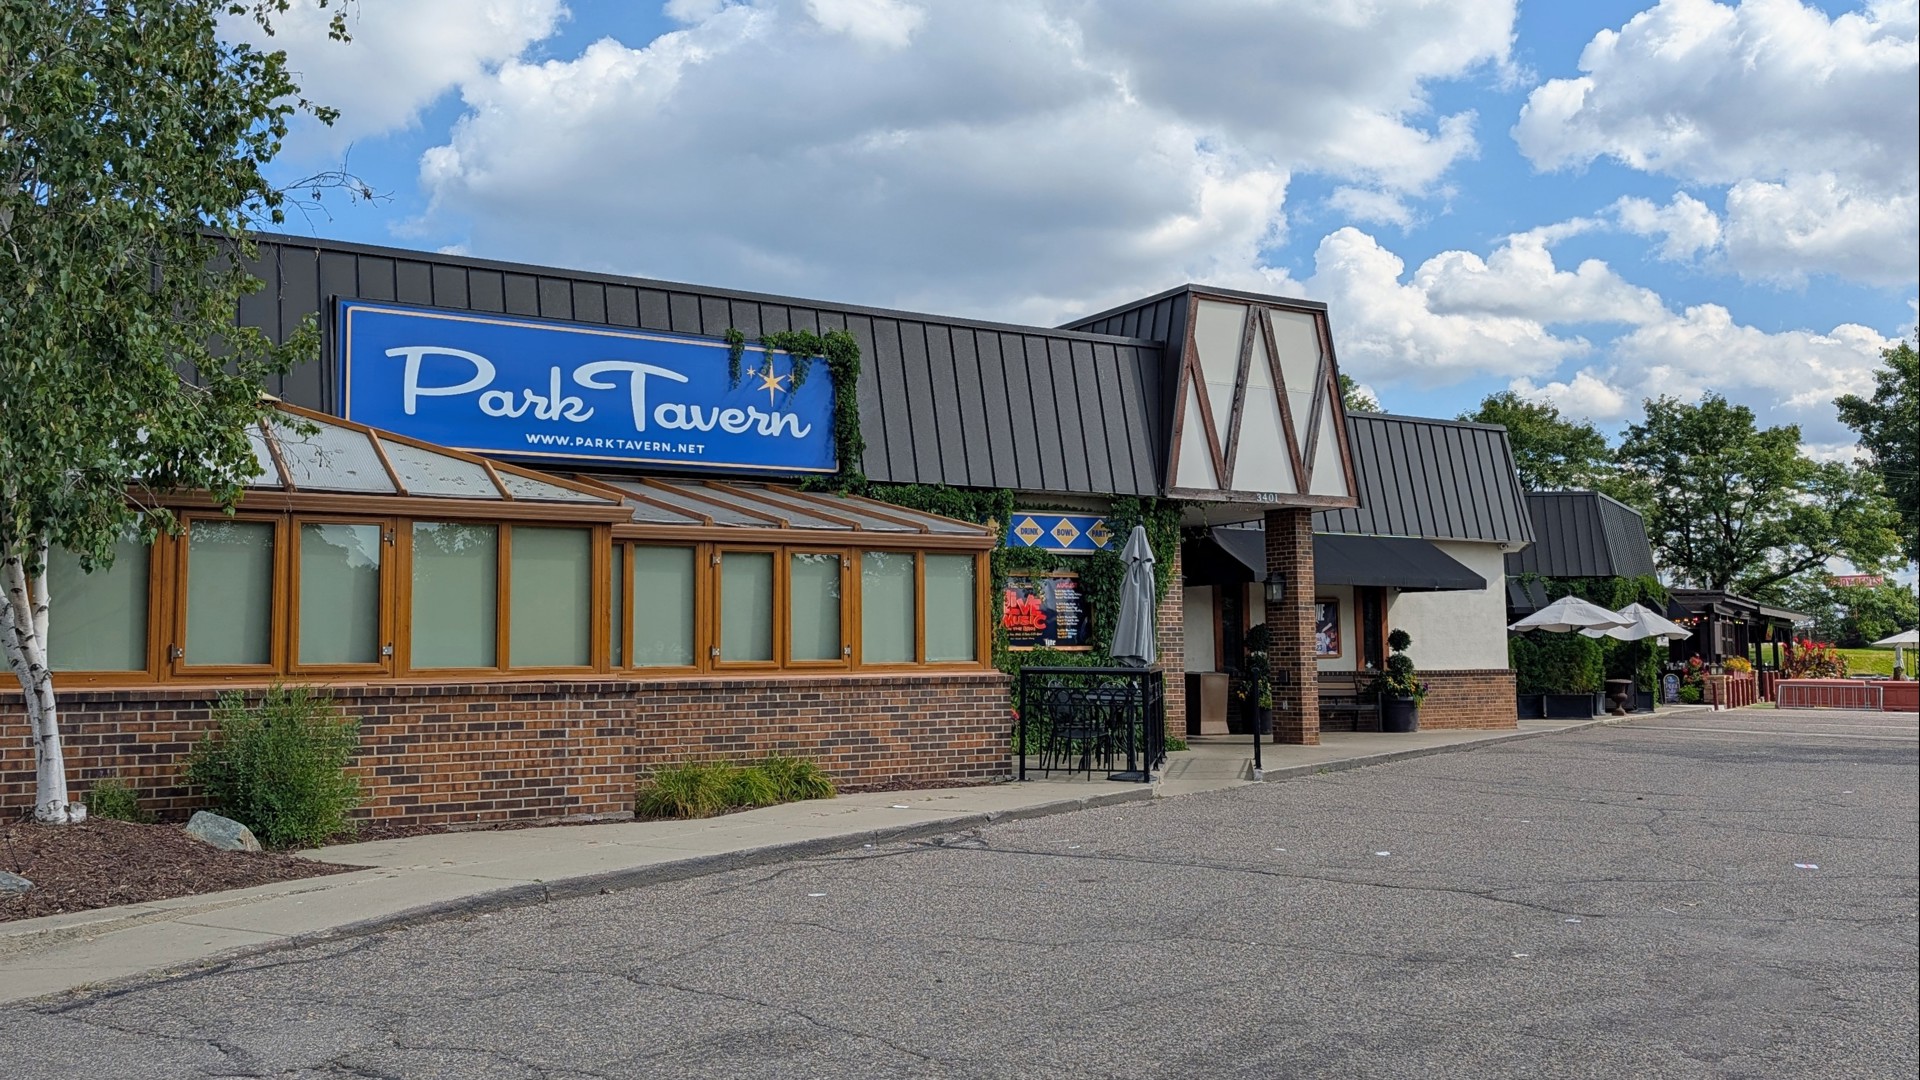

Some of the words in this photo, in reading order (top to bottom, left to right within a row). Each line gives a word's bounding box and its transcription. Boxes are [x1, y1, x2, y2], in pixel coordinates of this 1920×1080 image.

[385, 346, 594, 422] Park
[572, 360, 811, 439] Tavern
[525, 433, 705, 454] WWW.PARKTAVERN.NET
[1256, 493, 1278, 502] 3401
[1020, 527, 1039, 536] DRINK
[1056, 528, 1074, 537] BOWL
[1003, 613, 1047, 629] MUSIC
